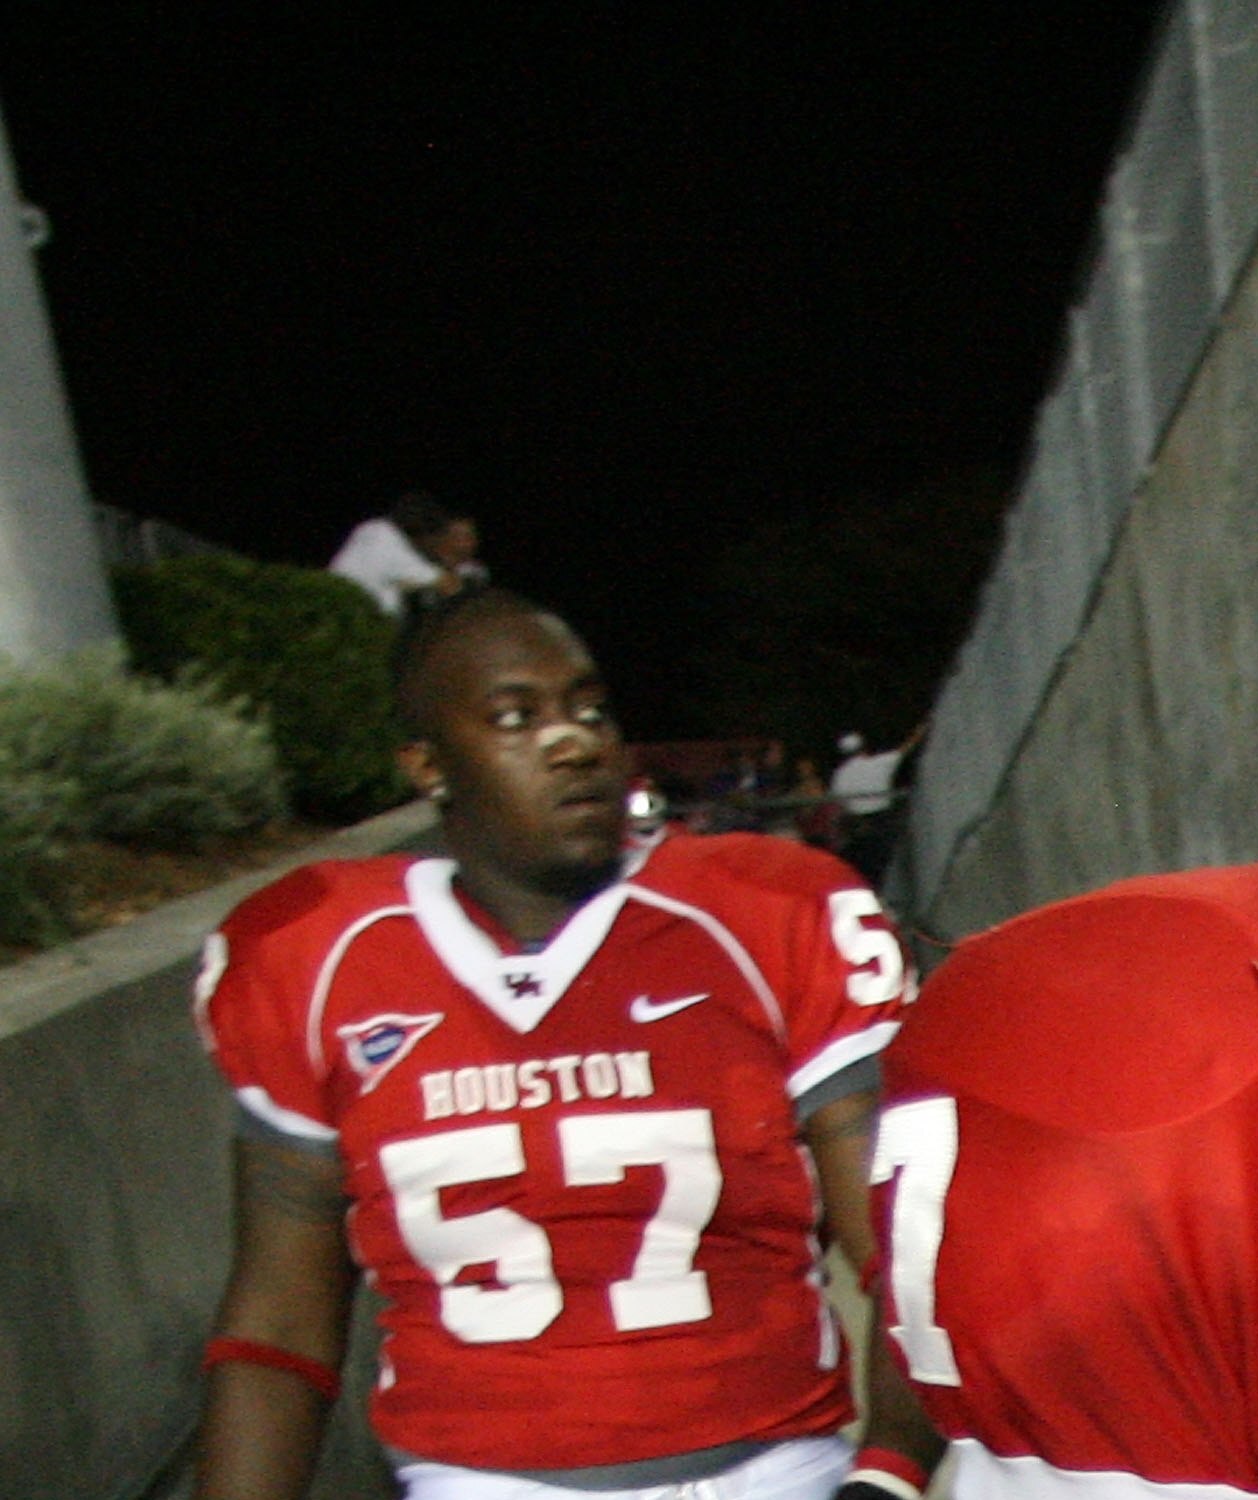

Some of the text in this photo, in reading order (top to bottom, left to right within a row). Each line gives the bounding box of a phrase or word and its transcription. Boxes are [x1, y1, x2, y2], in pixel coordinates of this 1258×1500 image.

[420, 1050, 654, 1120] HOUSTON
[378, 1106, 722, 1344] 57
[870, 1096, 960, 1388] 7
